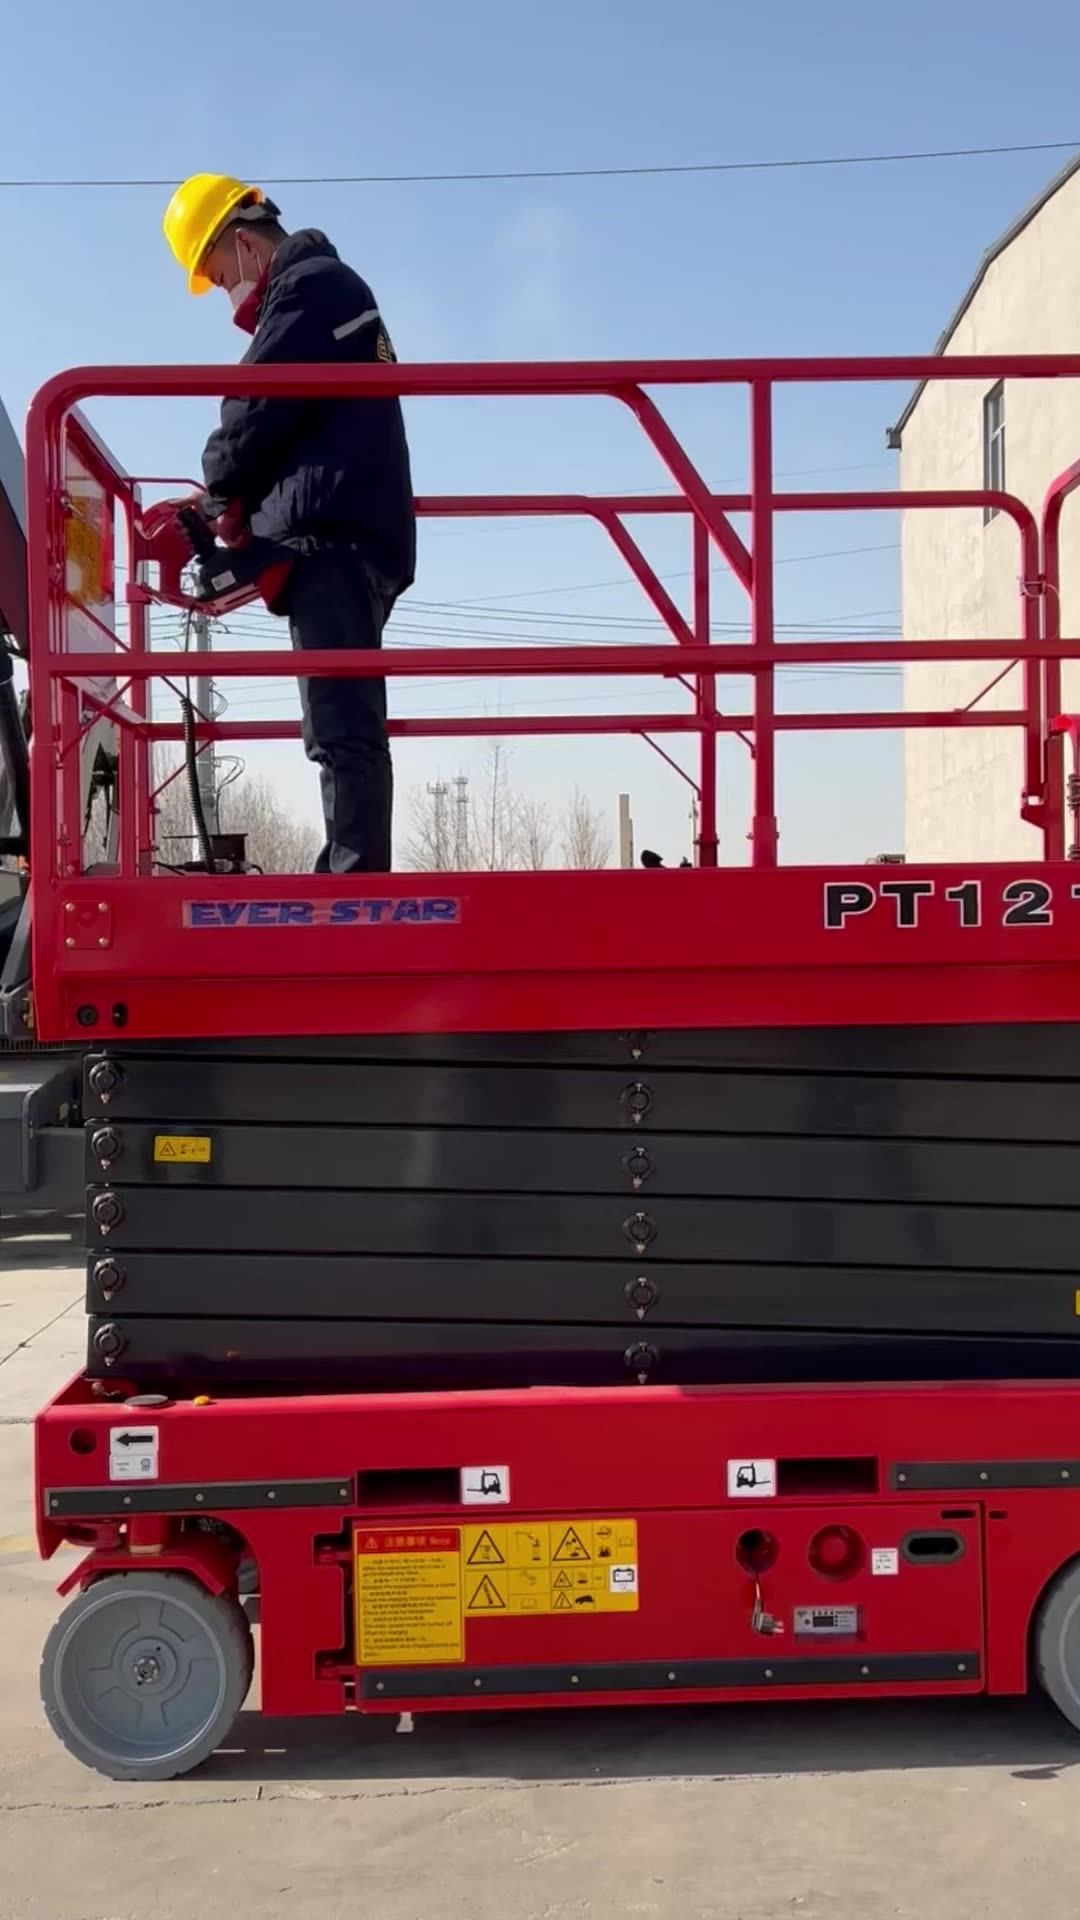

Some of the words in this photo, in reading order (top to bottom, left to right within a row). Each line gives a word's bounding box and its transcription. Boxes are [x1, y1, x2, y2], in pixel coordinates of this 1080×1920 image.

[191, 901, 314, 926] EVER
[328, 898, 458, 924] STAR
[824, 879, 1080, 929] PT12
